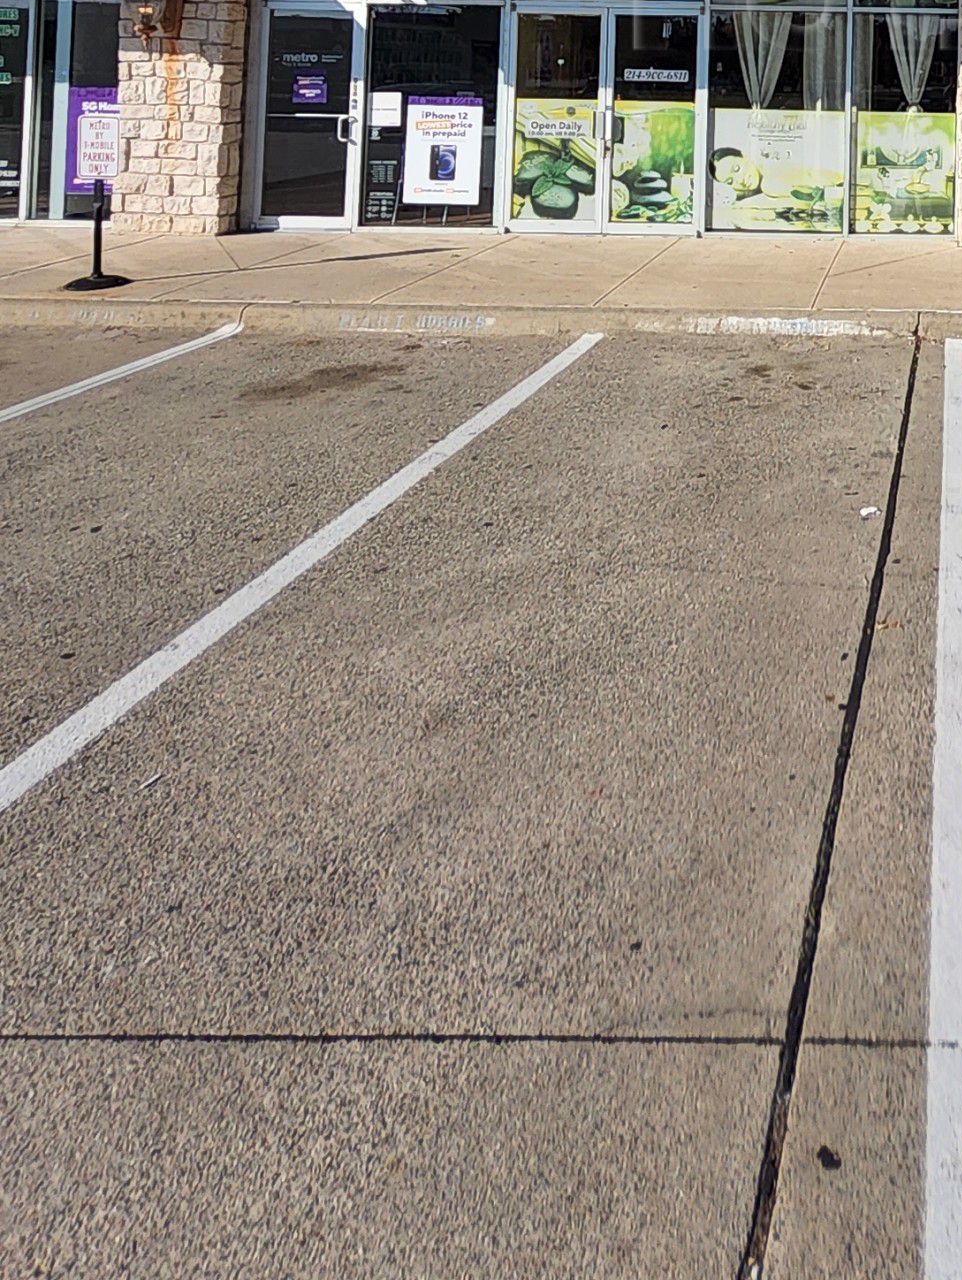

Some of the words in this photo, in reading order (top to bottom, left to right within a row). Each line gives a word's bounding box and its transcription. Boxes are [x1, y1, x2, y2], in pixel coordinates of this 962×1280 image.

[283, 52, 319, 62] metro
[421, 111, 456, 120] iPhone
[459, 112, 469, 120] 12
[451, 120, 473, 130] price
[531, 122, 557, 131] Open
[559, 122, 583, 132] Daily
[433, 130, 466, 139] prepaid
